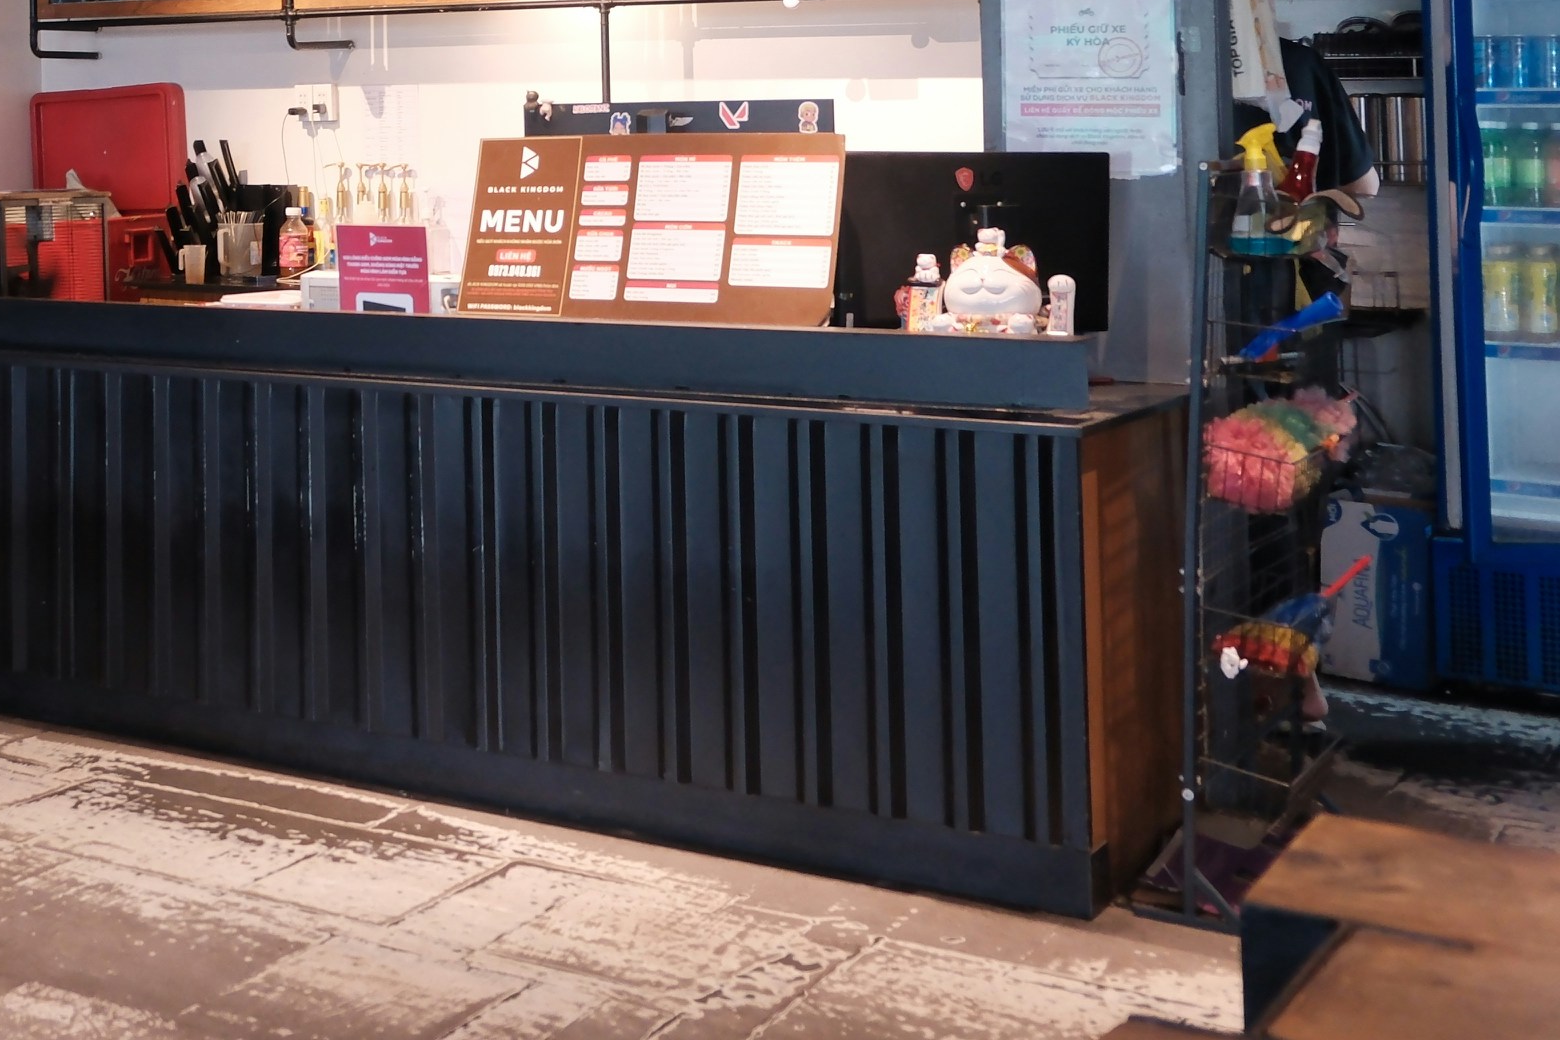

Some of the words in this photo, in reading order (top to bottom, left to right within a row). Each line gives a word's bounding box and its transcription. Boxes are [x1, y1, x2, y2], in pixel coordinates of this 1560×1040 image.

[1111, 25, 1127, 33] XE
[487, 186, 518, 194] BLACK
[520, 185, 564, 193] KINGDOM
[479, 209, 565, 234] MENU
[1351, 557, 1374, 629] AQUAFIN
